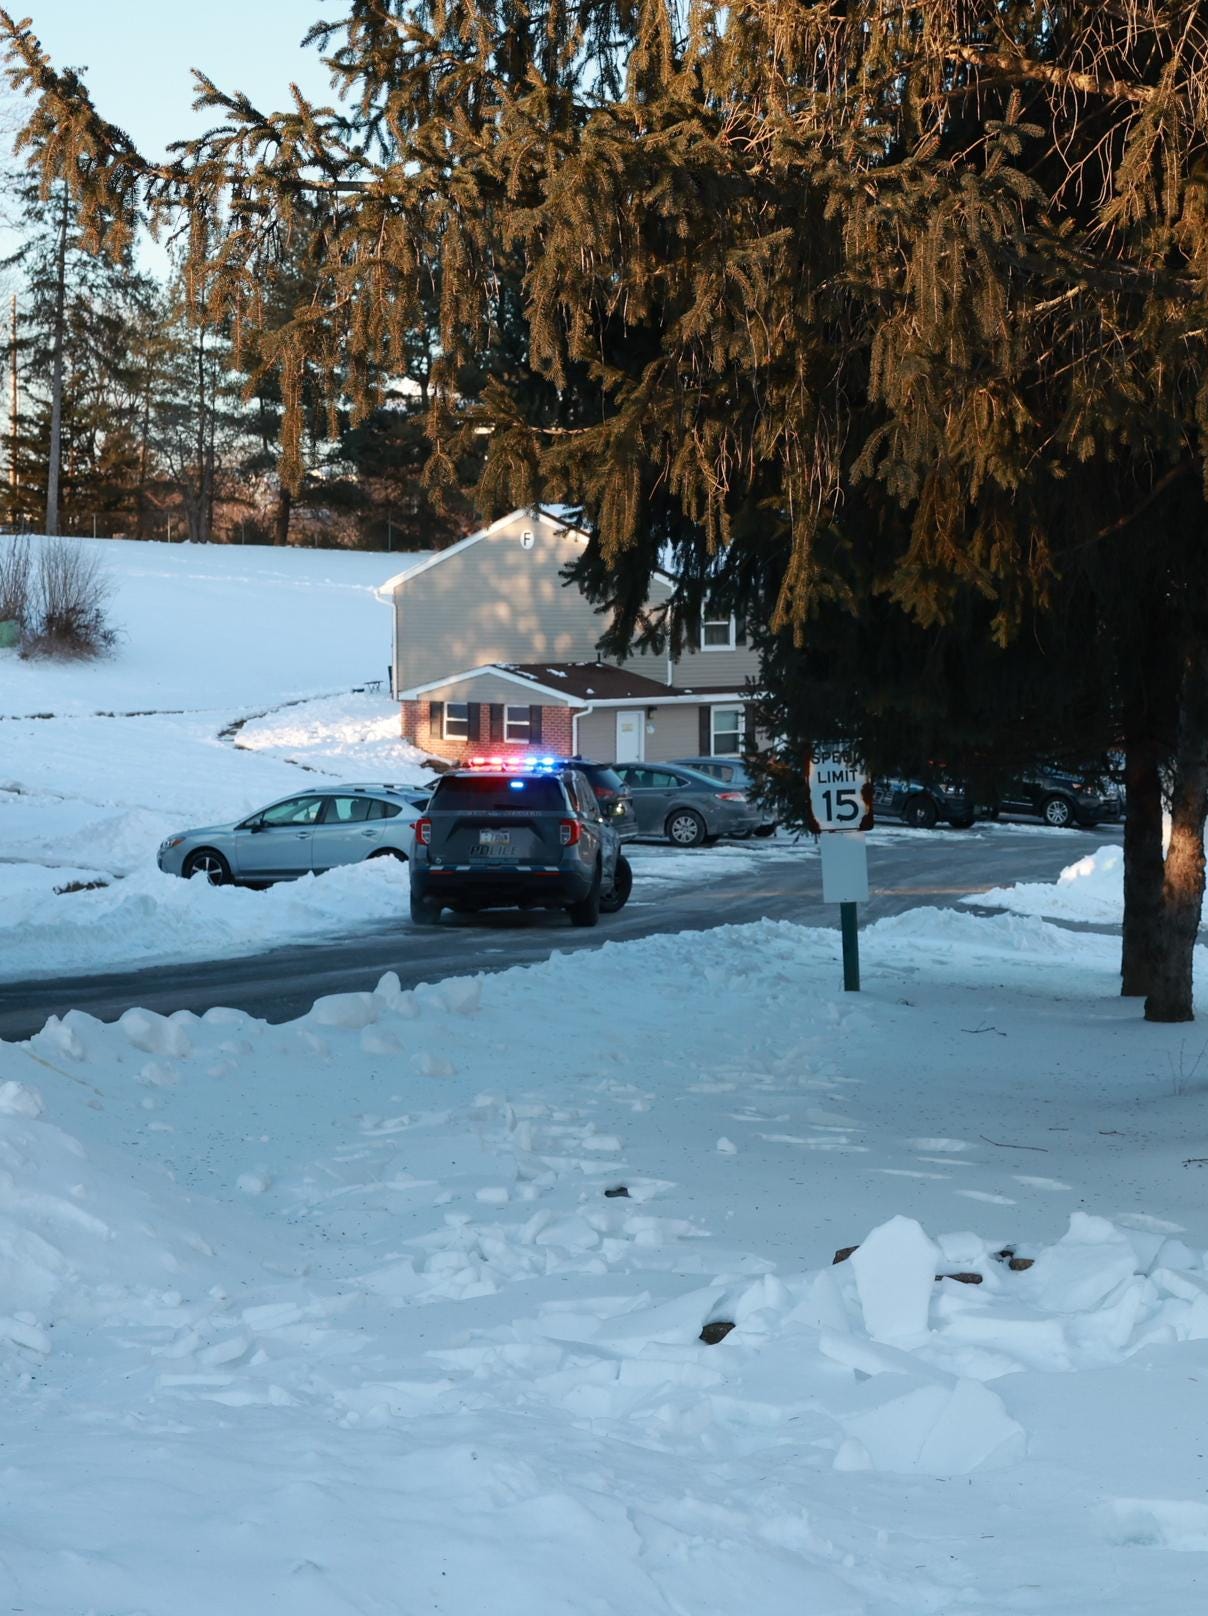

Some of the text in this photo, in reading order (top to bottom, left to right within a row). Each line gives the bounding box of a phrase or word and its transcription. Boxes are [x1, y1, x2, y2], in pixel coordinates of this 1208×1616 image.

[523, 532, 531, 546] F
[811, 751, 863, 765] SPE
[817, 769, 858, 783] LIMIT
[822, 789, 859, 821] 15
